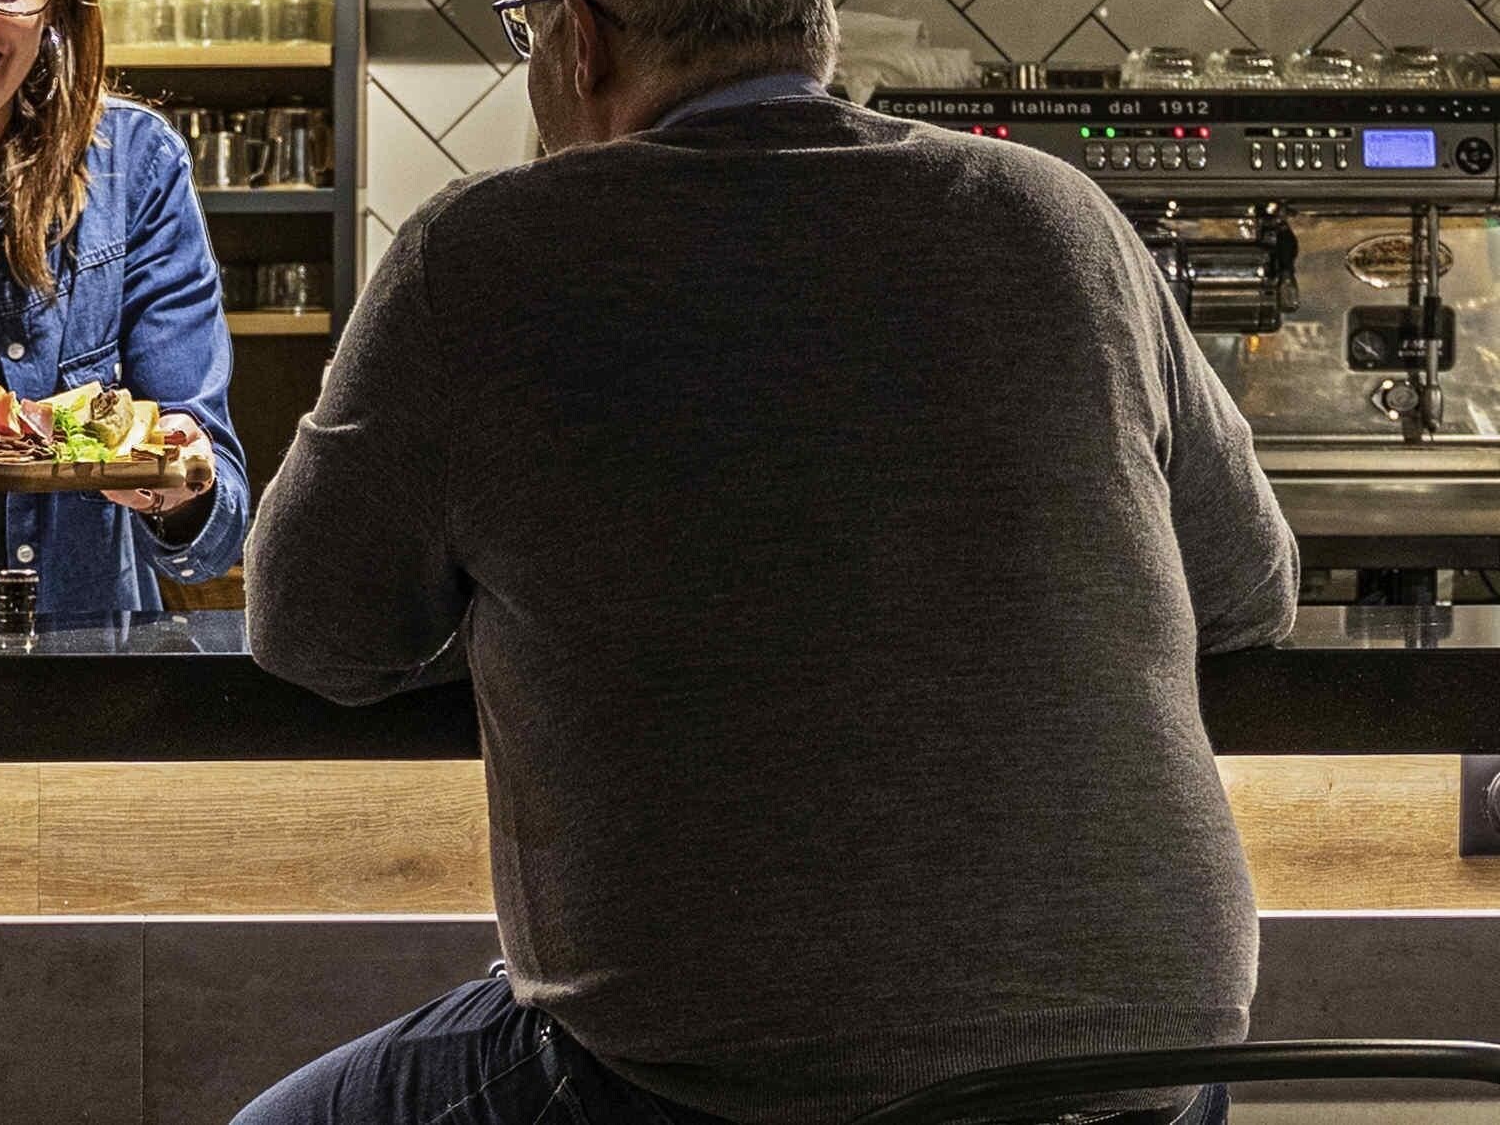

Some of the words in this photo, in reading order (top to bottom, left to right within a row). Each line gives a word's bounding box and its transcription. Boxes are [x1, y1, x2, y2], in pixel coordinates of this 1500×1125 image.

[878, 100, 994, 115] Eccellenza
[1011, 100, 1092, 114] italiana
[1108, 100, 1141, 114] dal
[1160, 100, 1209, 114] 1912
